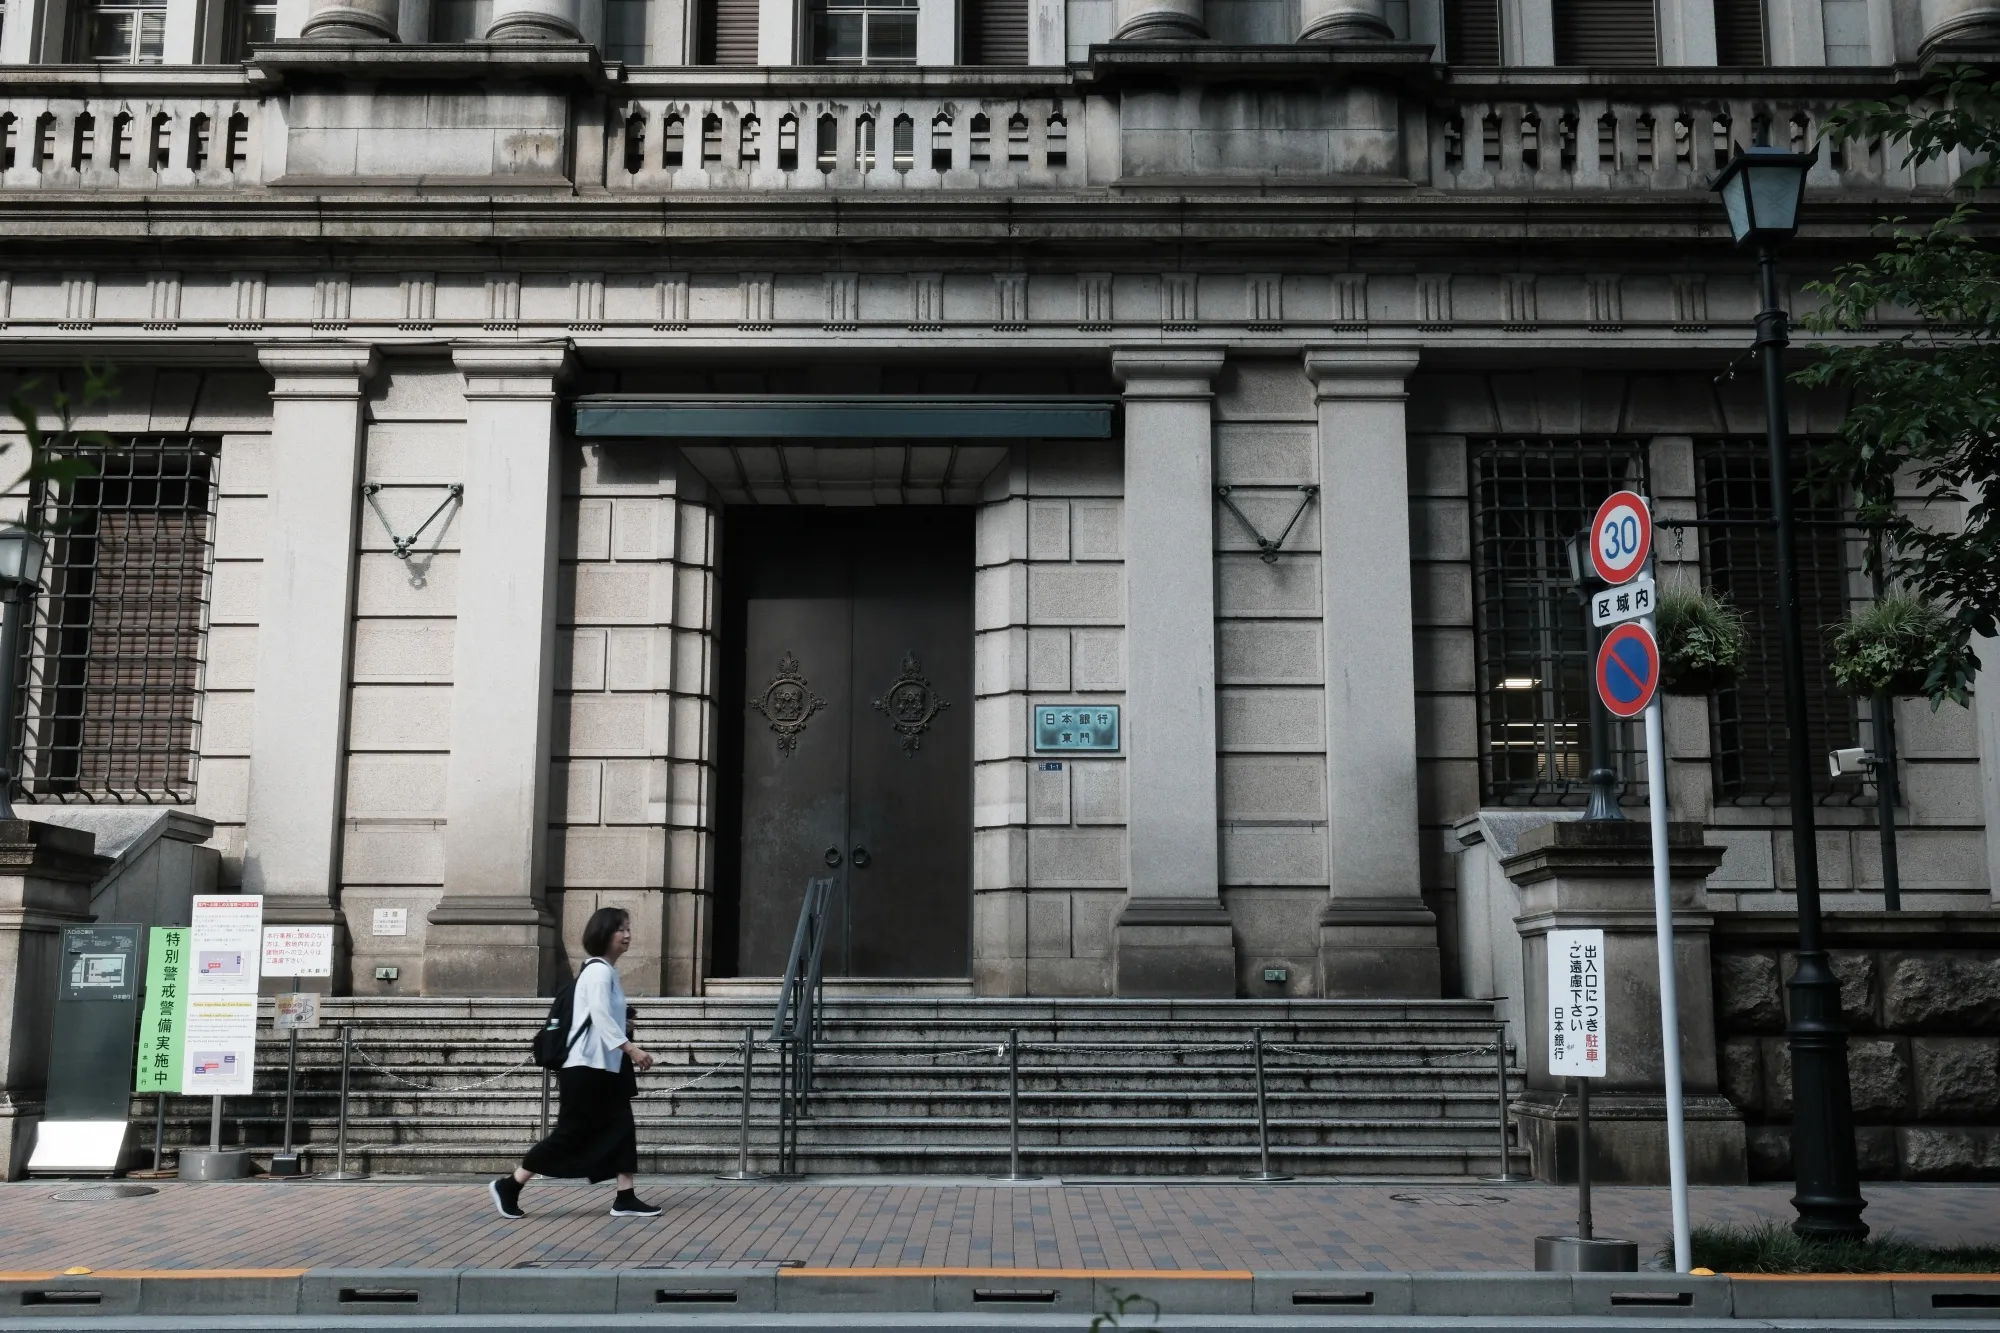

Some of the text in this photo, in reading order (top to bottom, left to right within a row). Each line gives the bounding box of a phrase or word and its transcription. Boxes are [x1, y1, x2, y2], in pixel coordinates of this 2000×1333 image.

[1604, 515, 1638, 559] 30
[1598, 588, 1649, 618] 区域内
[1045, 713, 1108, 725] 日本銀行
[1061, 732, 1090, 744] 東門
[154, 931, 181, 1086] 特別警戒警備実施中
[1569, 944, 1583, 1032] ご遠慮下さい
[1584, 944, 1599, 1063] 出入口につき駐車
[1554, 1007, 1565, 1061] 日本銀行
[140, 1042, 149, 1086] 日本銀行
